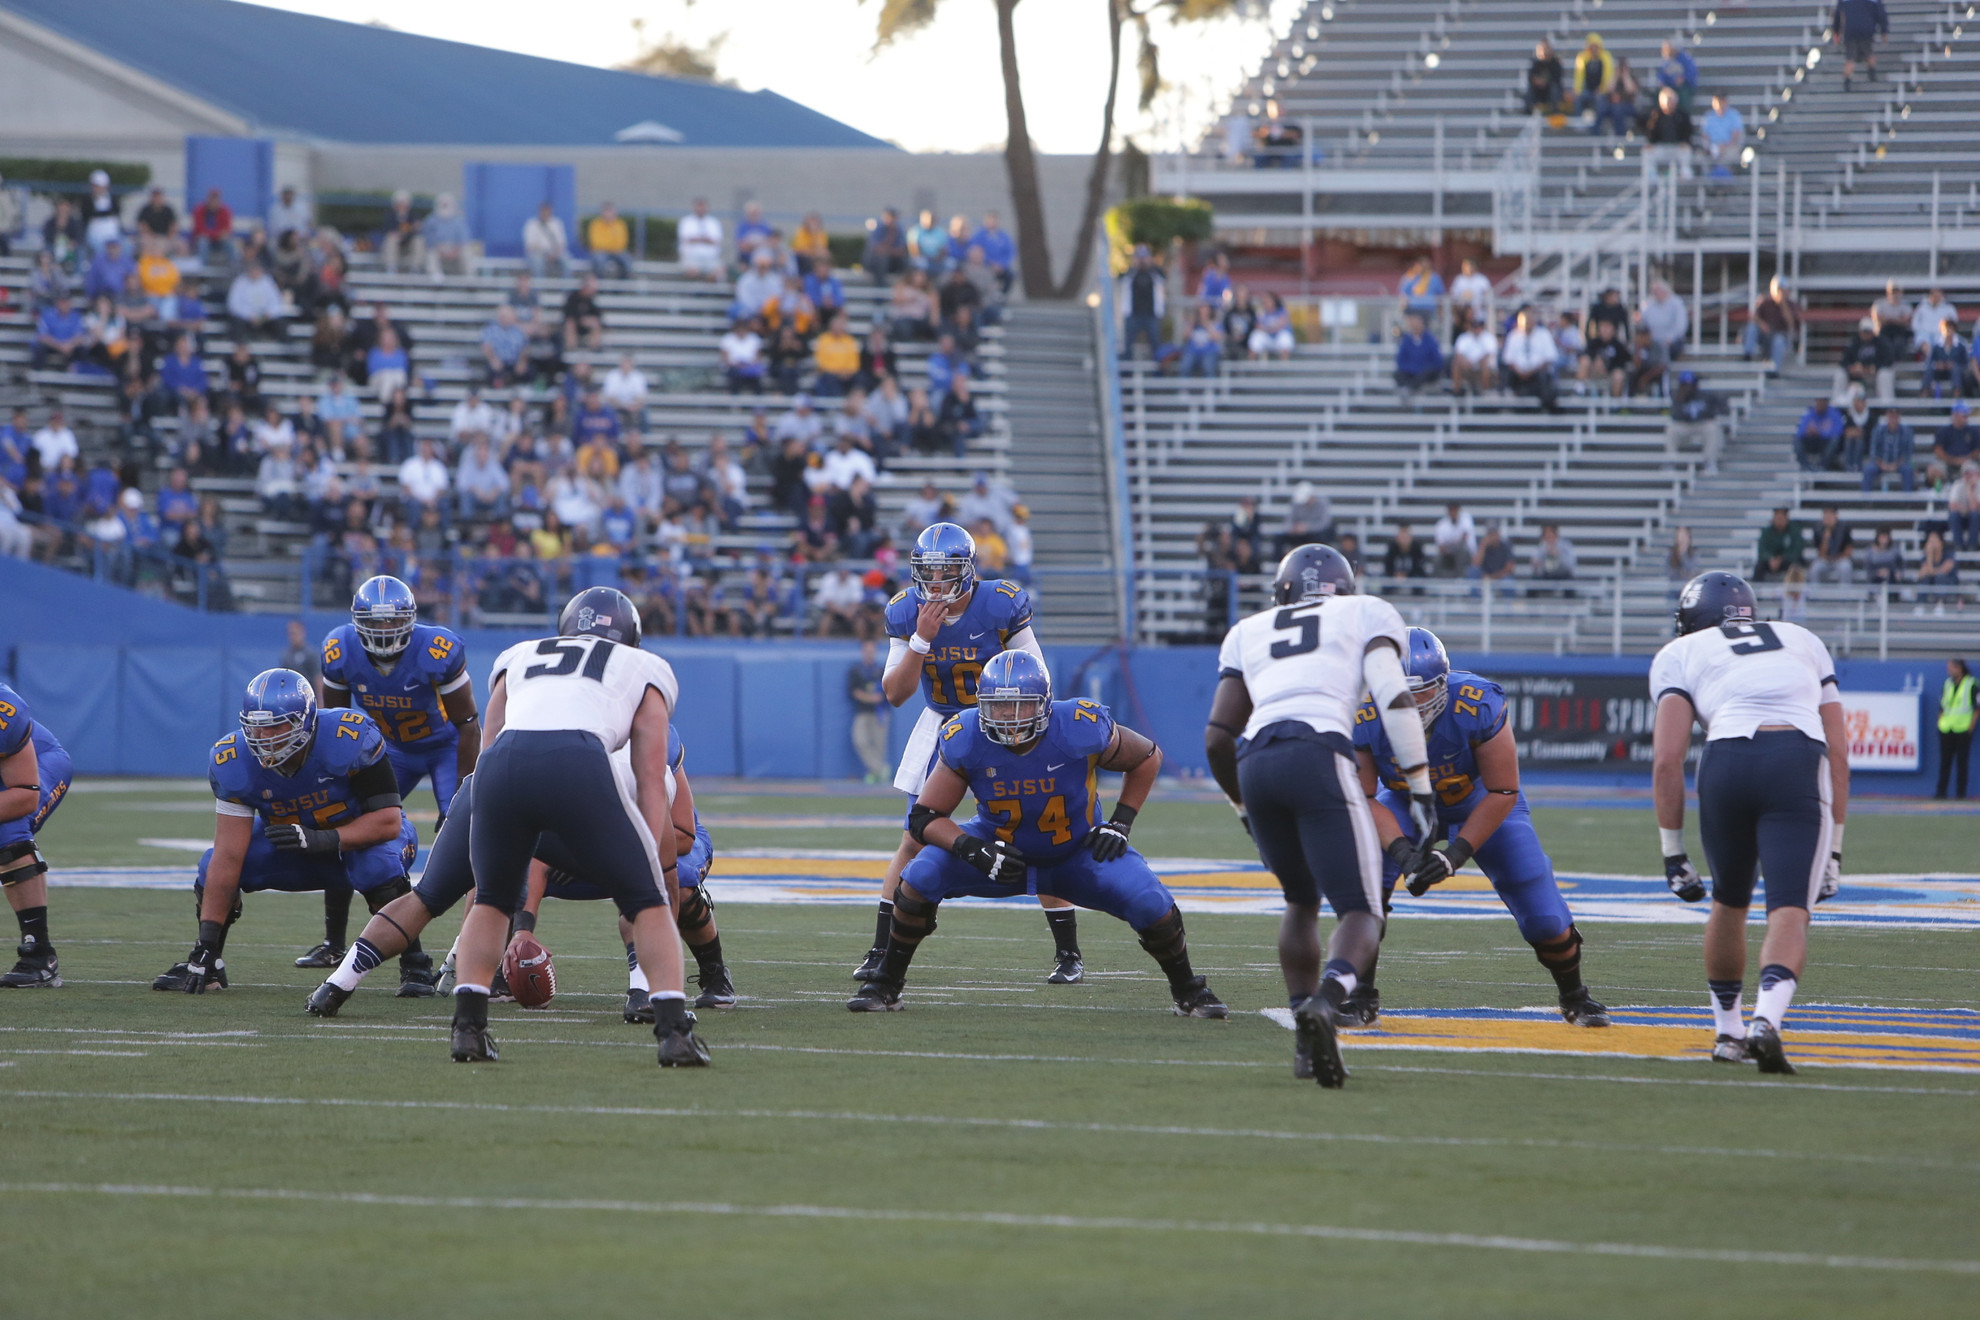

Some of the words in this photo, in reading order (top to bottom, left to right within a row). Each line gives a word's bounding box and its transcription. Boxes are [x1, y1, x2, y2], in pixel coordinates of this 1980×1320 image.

[995, 580, 1021, 599] 10
[1270, 601, 1325, 660] 5
[324, 638, 341, 664] 42
[427, 635, 454, 661] 42
[524, 638, 618, 684] 51
[924, 646, 977, 662] SJSU
[924, 662, 984, 706] 10
[363, 694, 412, 709] SJSU
[1073, 699, 1101, 723] 74
[1454, 684, 1485, 717] 72
[336, 712, 364, 741] 75
[215, 734, 237, 764] 75
[992, 777, 1056, 797] SJSU
[272, 789, 329, 815] SJSU
[986, 794, 1073, 846] 74
